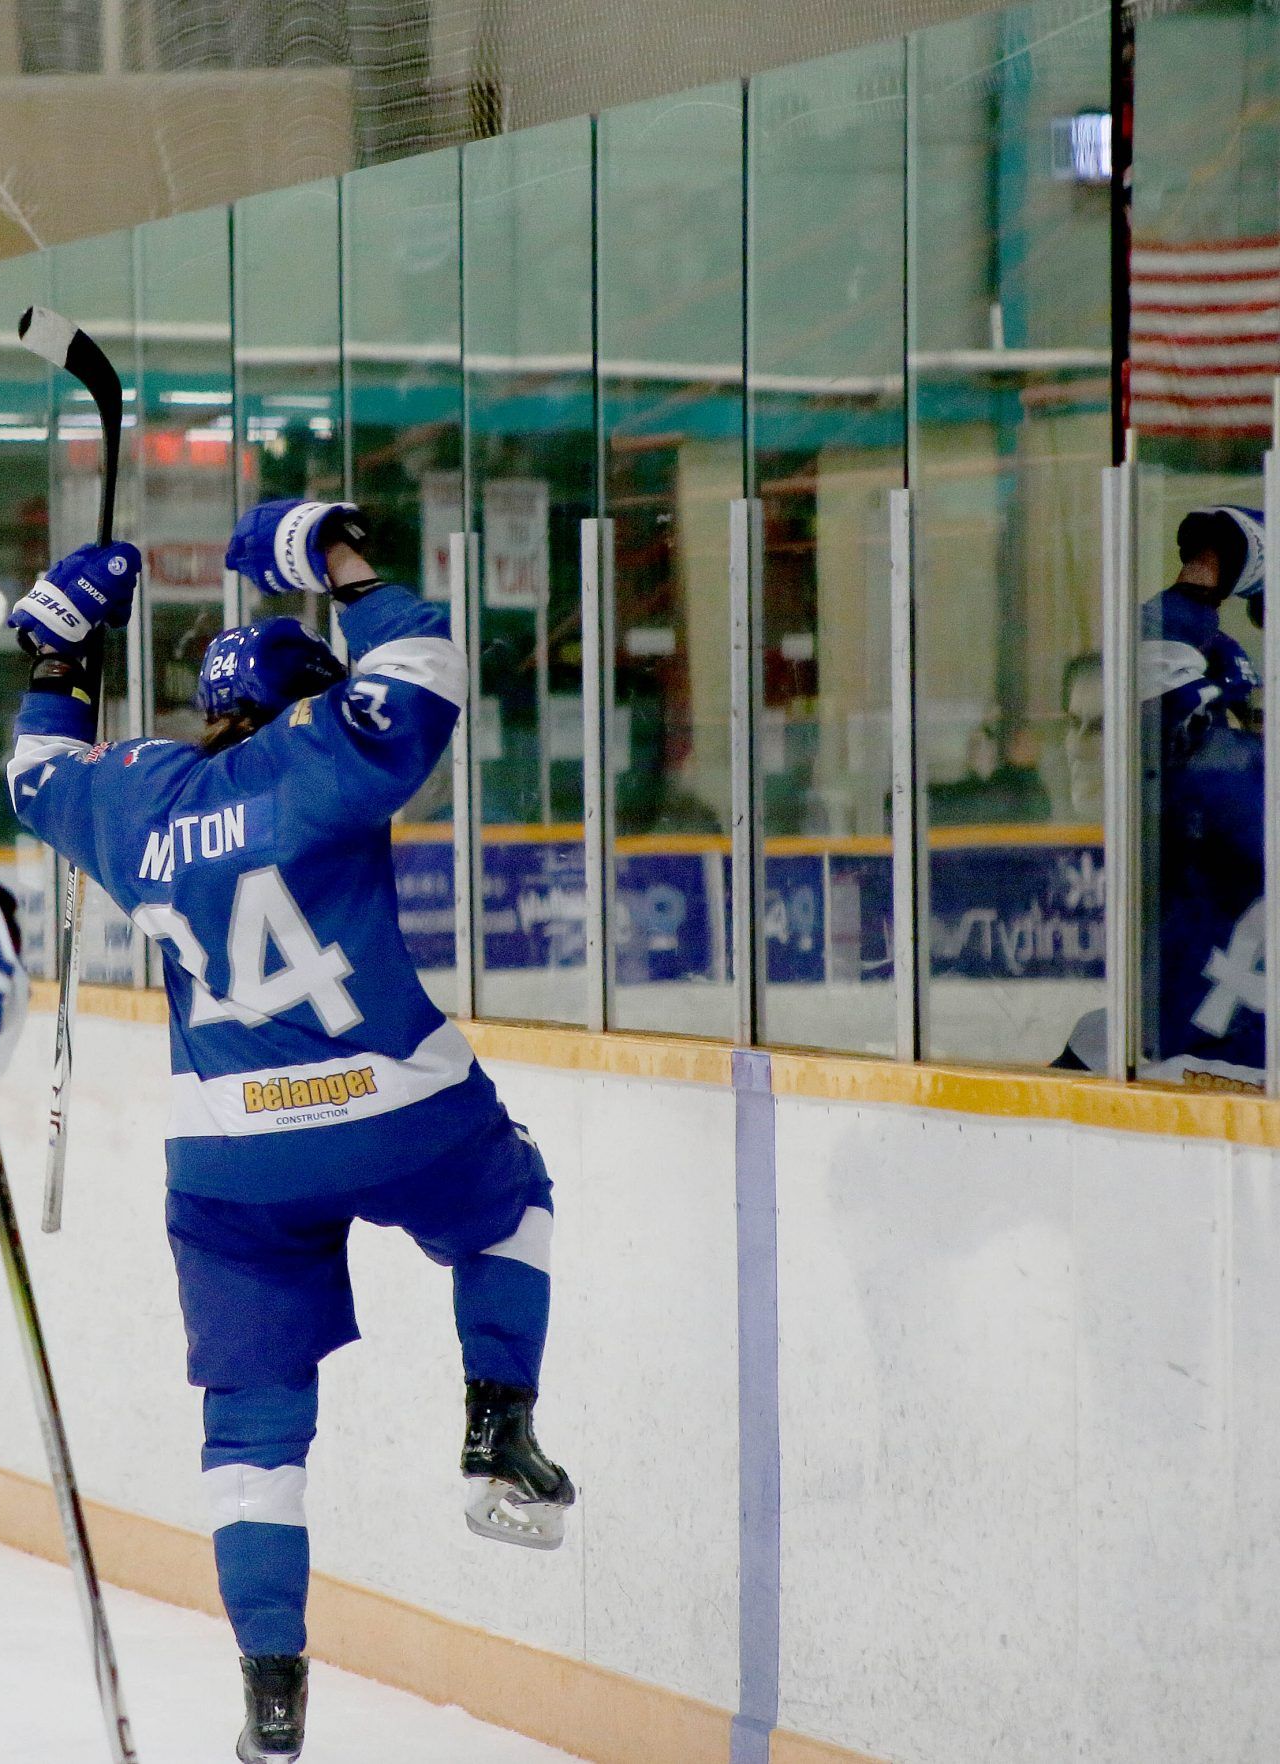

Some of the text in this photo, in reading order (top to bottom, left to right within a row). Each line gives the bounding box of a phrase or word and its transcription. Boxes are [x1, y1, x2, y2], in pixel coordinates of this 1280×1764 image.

[76, 577, 108, 605] REKKER
[209, 652, 237, 681] 24
[131, 864, 365, 1038] 24
[242, 1066, 378, 1114] Bélanger
[275, 1108, 349, 1125] CONSTRUCTION
